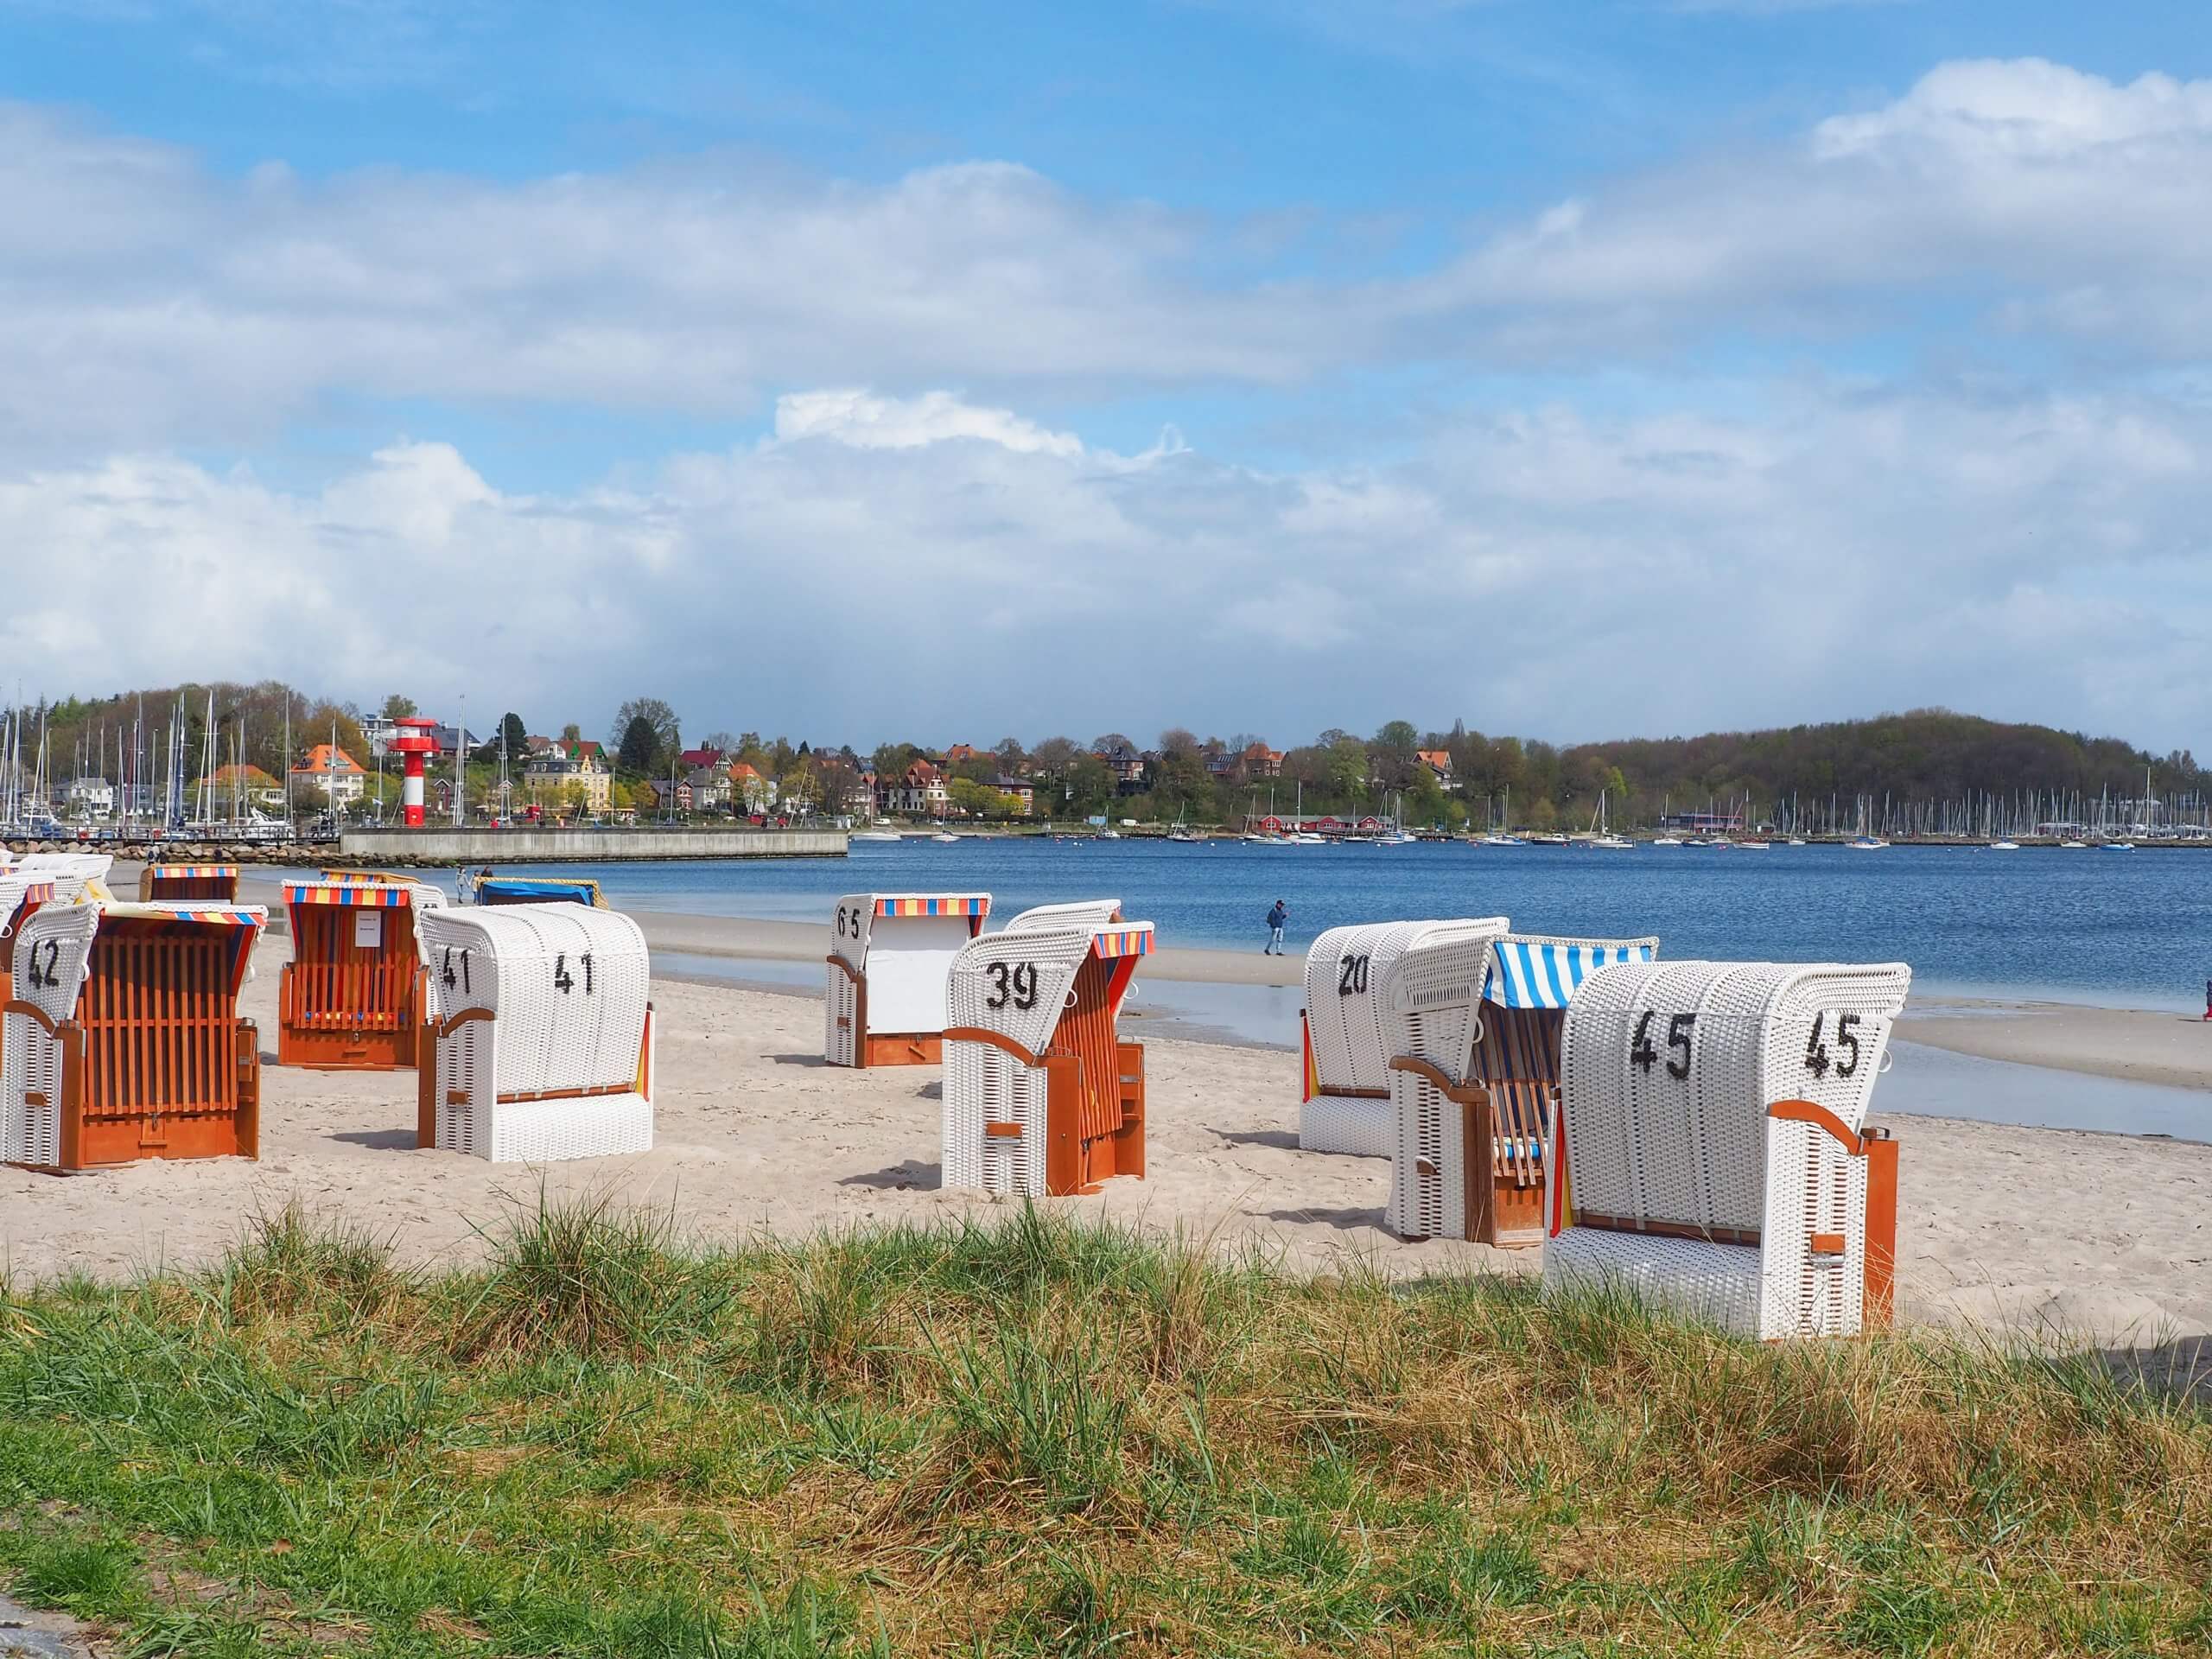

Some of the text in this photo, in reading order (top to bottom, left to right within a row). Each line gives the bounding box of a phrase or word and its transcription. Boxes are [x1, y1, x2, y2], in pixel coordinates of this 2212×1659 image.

[837, 906, 860, 939] 65
[29, 940, 59, 989] 42
[442, 947, 471, 994] 41
[555, 953, 594, 995] 41
[987, 962, 1038, 1010] 39
[1338, 955, 1369, 996] 20
[1630, 1011, 1696, 1080] 45
[1805, 1011, 1860, 1078] 45
